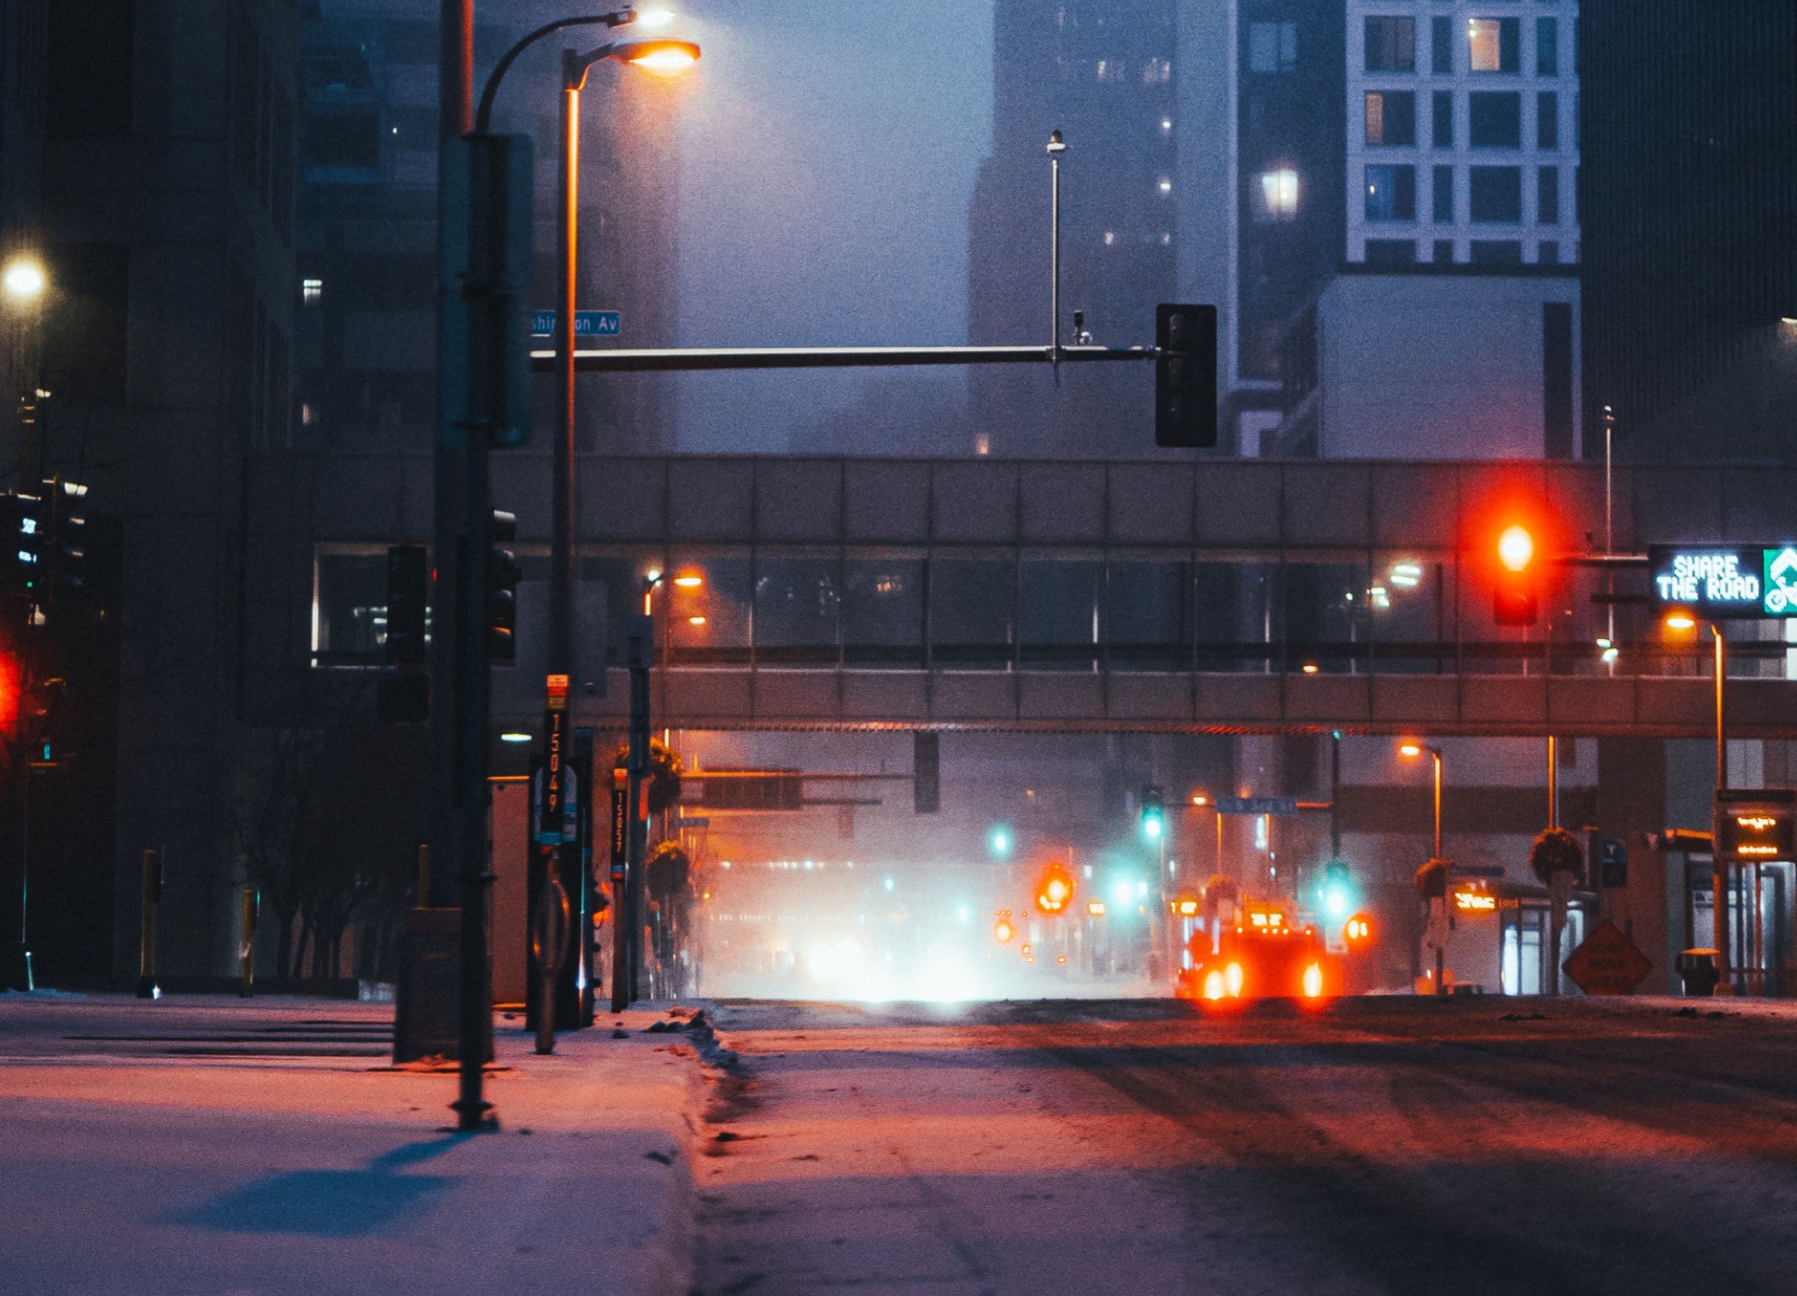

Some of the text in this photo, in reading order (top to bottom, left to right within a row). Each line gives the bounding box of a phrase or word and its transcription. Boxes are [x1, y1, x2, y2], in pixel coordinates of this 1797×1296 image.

[598, 316, 617, 331] Av
[1673, 554, 1739, 579] SHARE
[1656, 576, 1760, 601] THE ROAD
[549, 713, 560, 812] 15049
